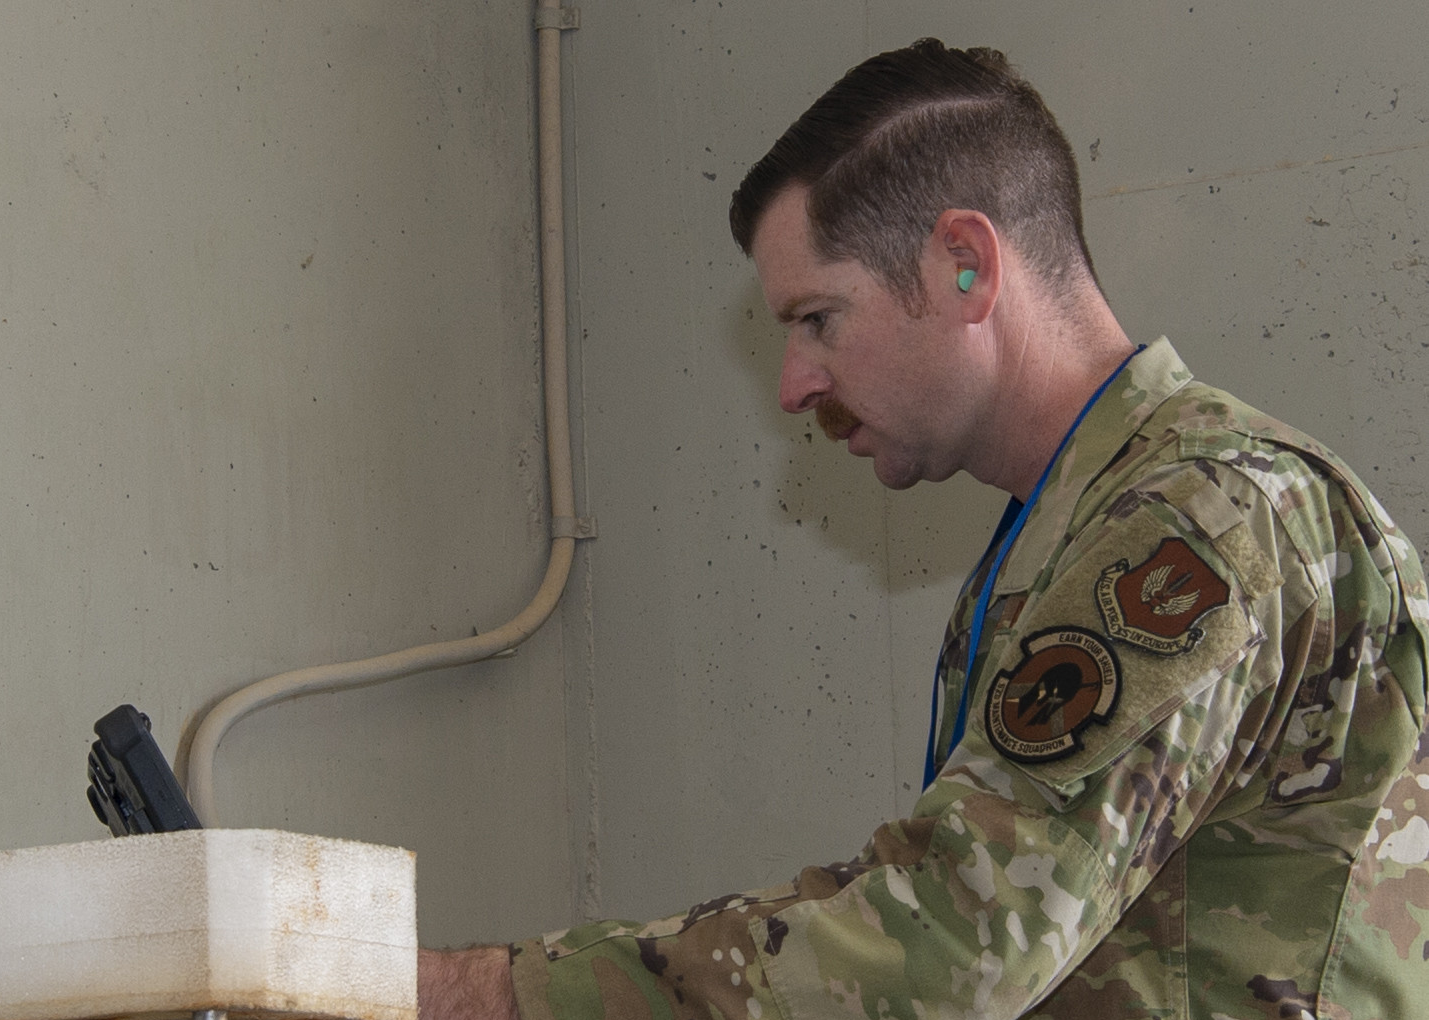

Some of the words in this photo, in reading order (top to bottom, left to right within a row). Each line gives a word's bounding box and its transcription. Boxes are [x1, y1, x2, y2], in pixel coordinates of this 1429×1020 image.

[1100, 593, 1113, 608] AIR
[1130, 631, 1143, 643] IN
[1141, 637, 1183, 651] EUROPE
[1058, 633, 1082, 644] EARN
[1083, 638, 1102, 655] YOUR
[1099, 655, 1113, 686] SHIELD
[1018, 739, 1066, 754] SQUADRON
